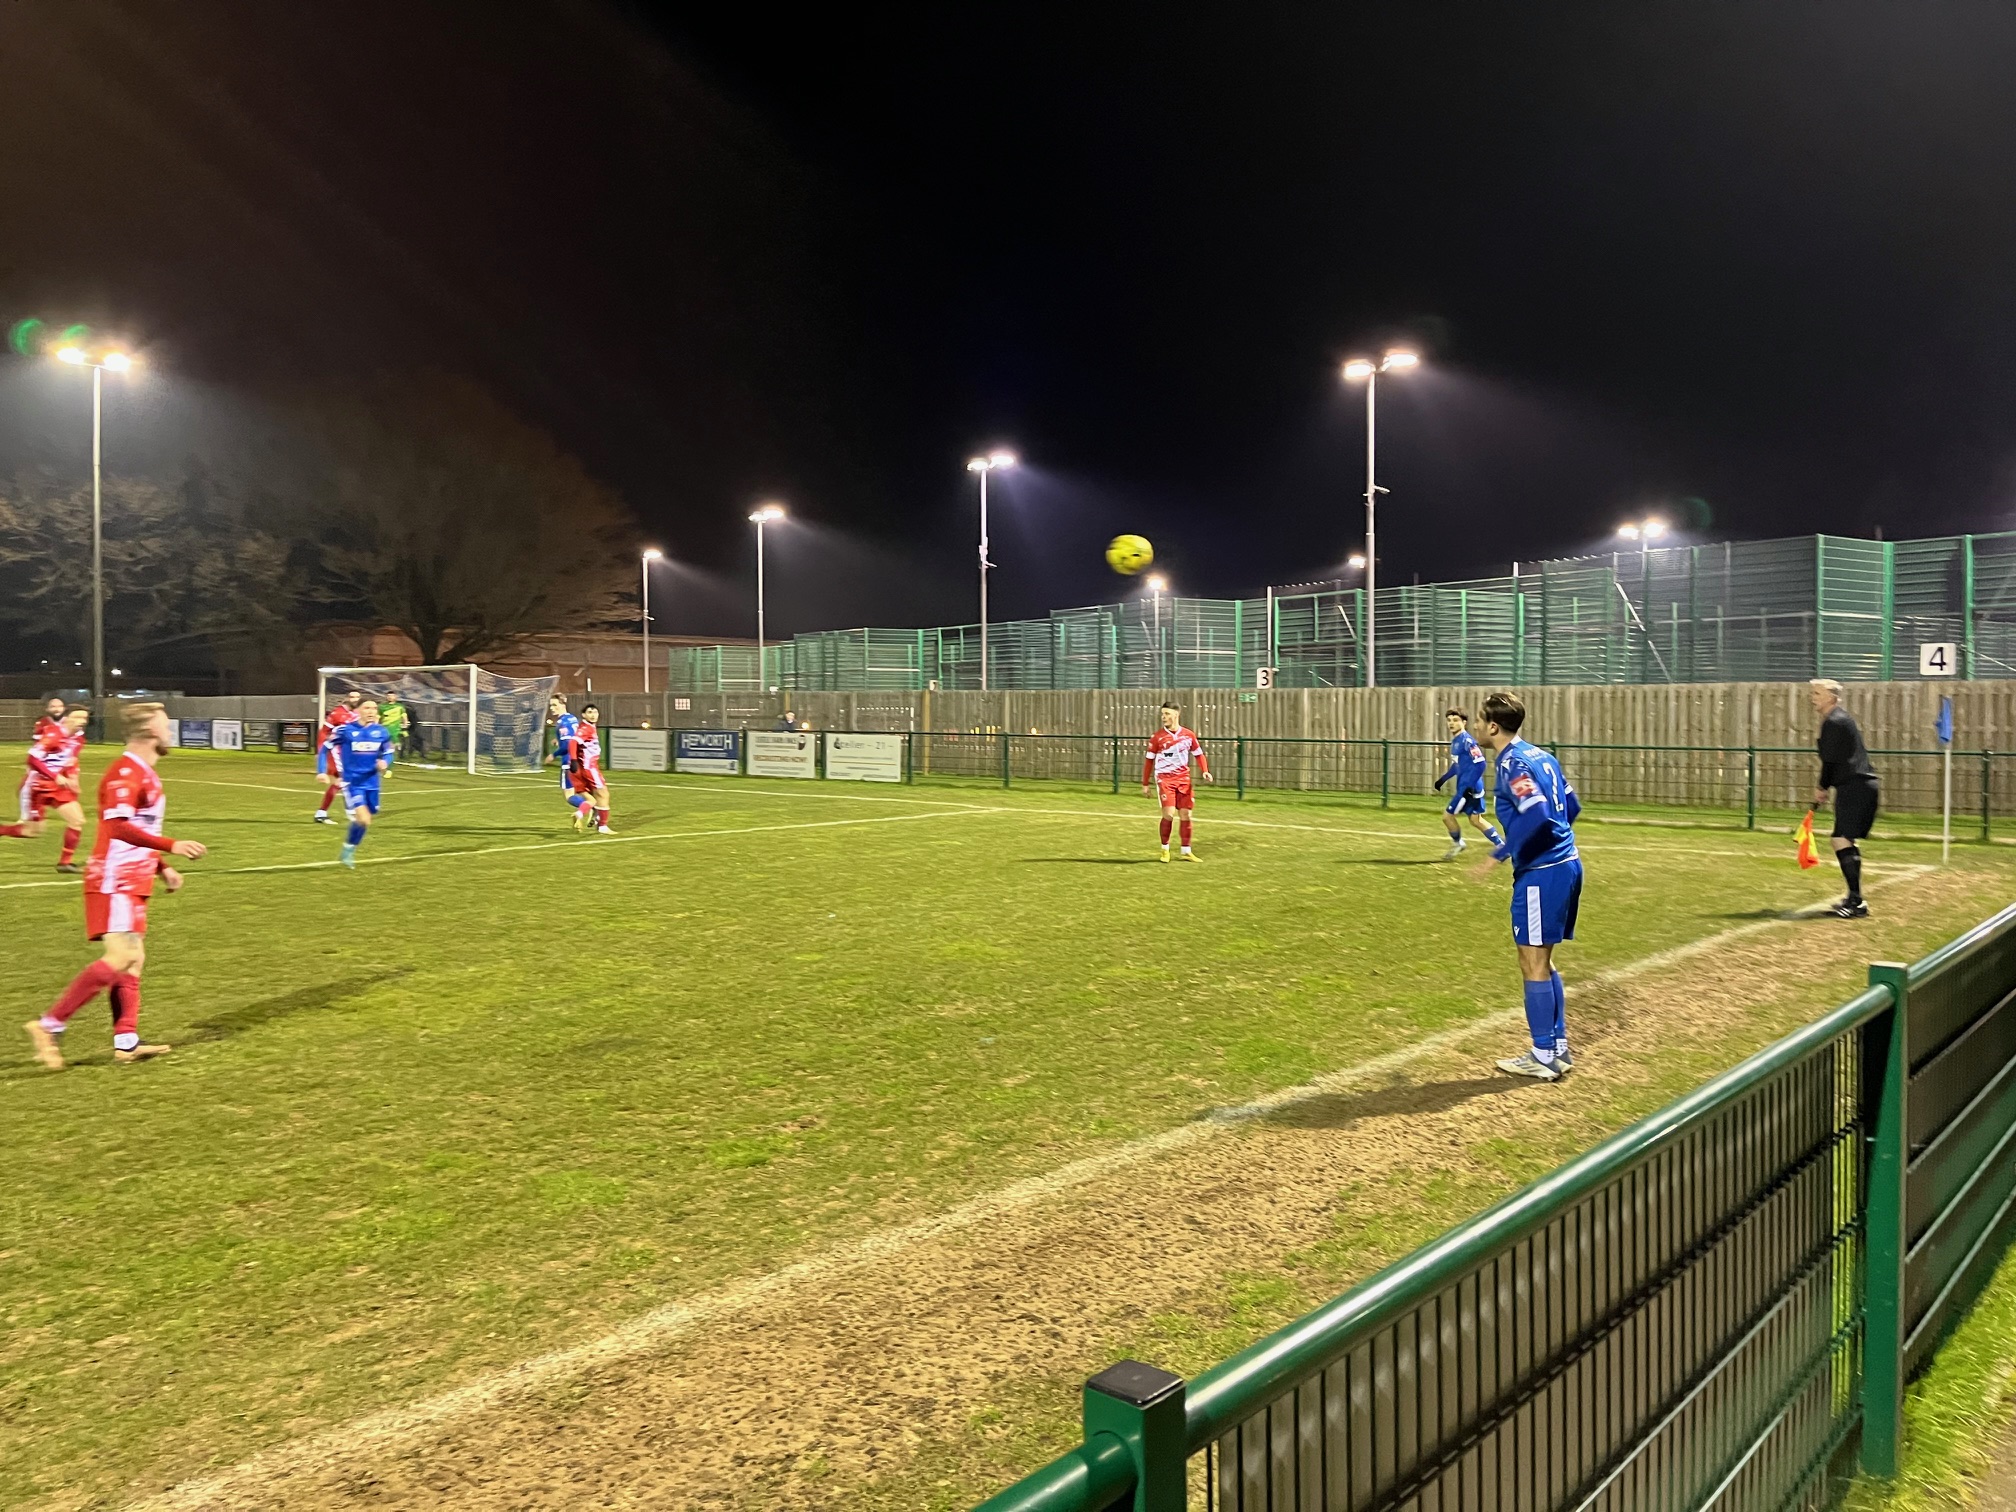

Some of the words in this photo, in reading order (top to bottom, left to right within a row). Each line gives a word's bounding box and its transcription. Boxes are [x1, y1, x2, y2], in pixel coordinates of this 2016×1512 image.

[1929, 646, 1947, 671] 4
[1261, 669, 1269, 686] 3
[681, 733, 733, 750] HEPWORTH
[1542, 762, 1564, 812] 2
